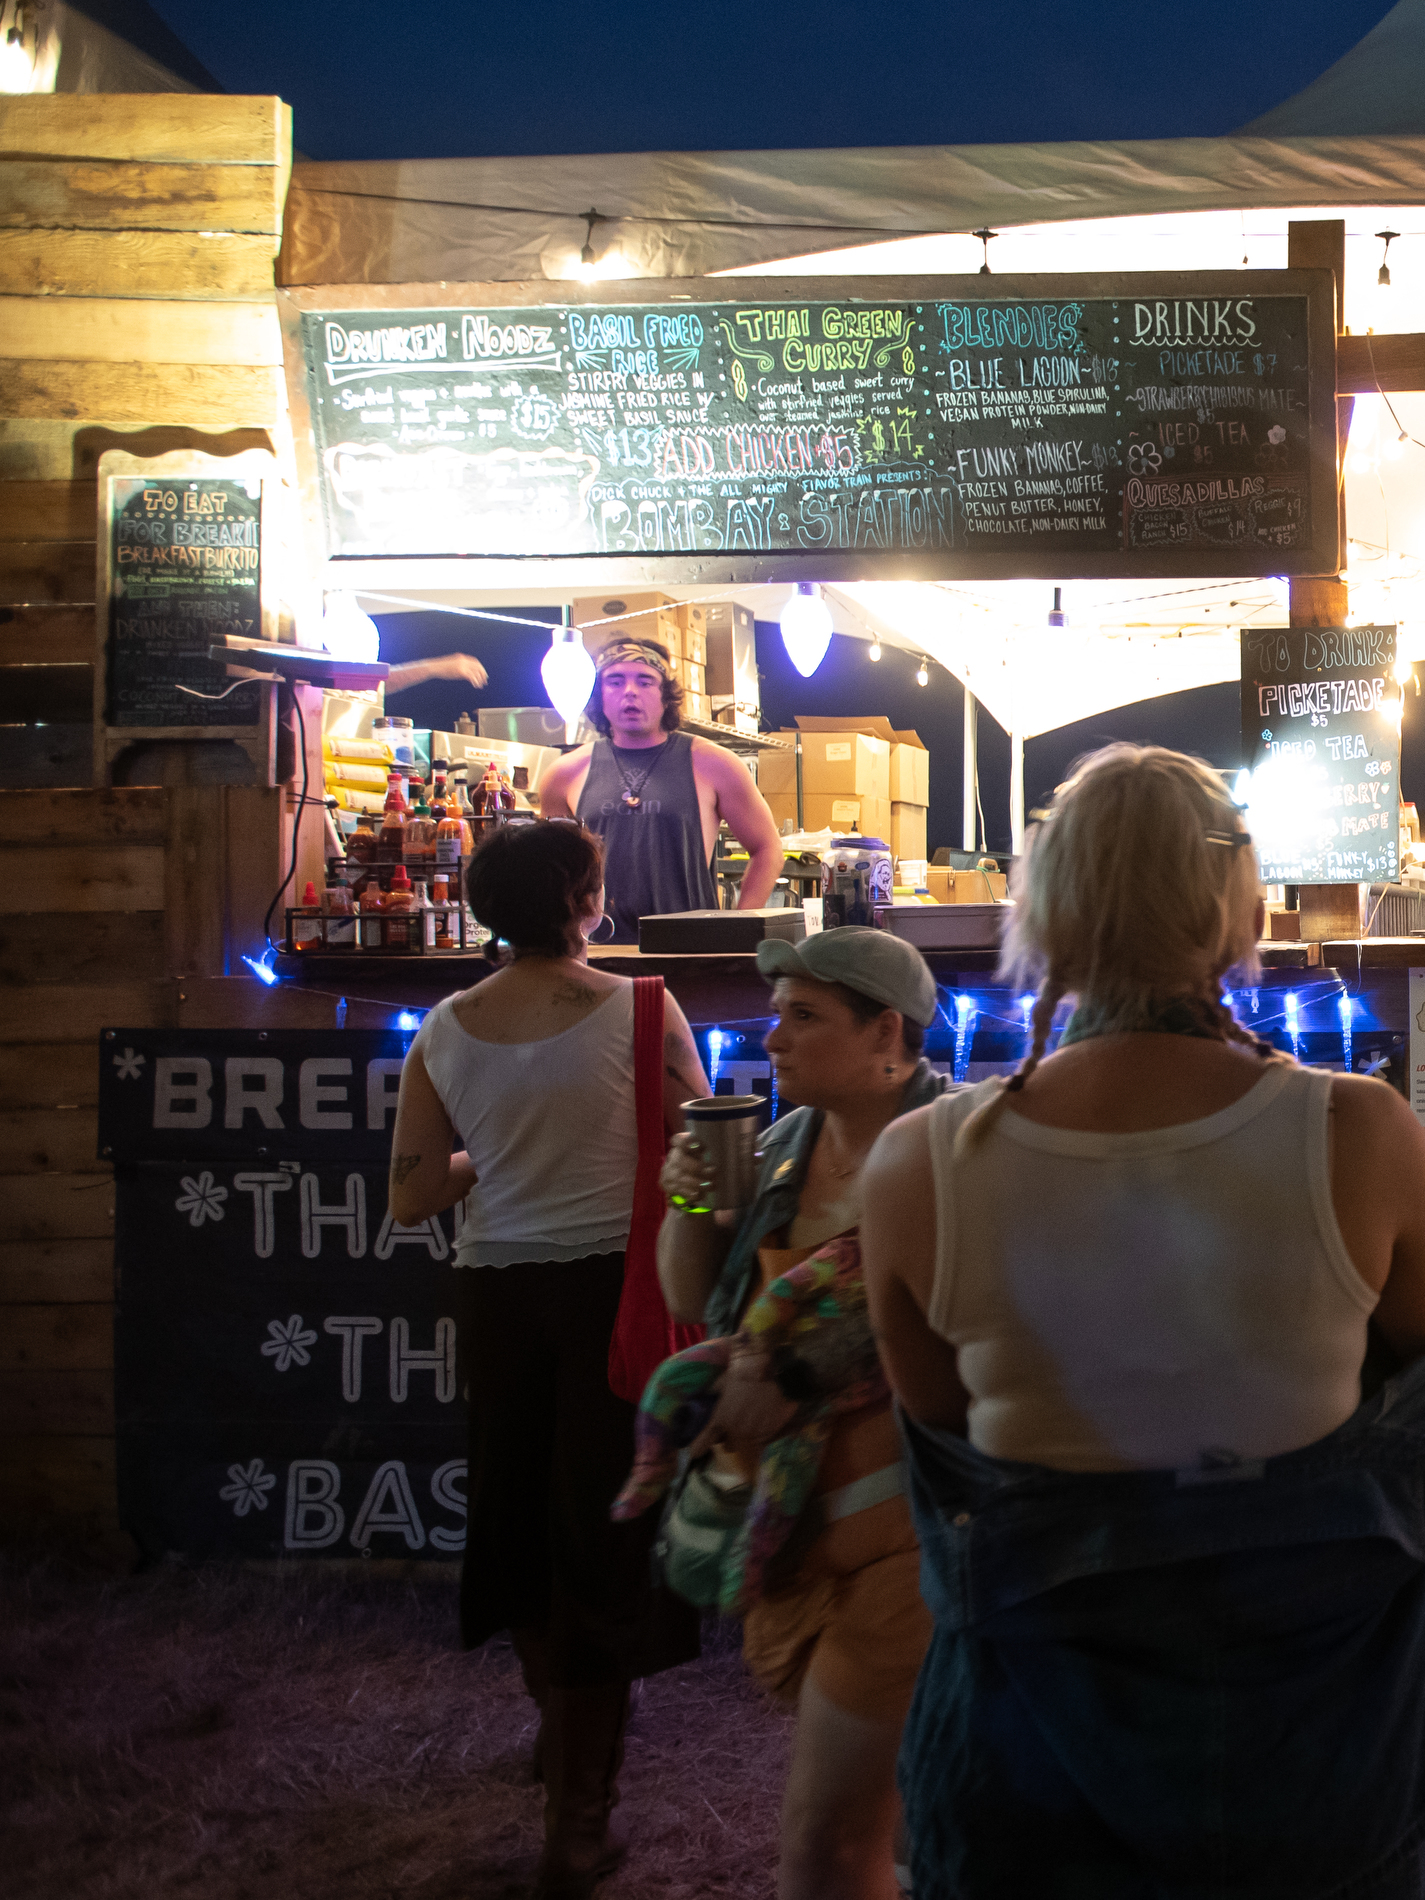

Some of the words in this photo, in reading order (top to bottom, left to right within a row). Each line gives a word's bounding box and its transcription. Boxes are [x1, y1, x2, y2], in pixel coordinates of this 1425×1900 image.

[569, 313, 640, 350] BASIL
[644, 314, 703, 348] FRIED
[736, 309, 811, 342] THAI
[822, 306, 903, 339] GREEN
[944, 305, 1078, 350] BLENDIES
[1134, 299, 1257, 338] DRINKS
[326, 322, 446, 363] DRUNKEN
[462, 315, 556, 359] NOODZ
[612, 350, 660, 376] RICE
[783, 338, 873, 373] CURRY
[1159, 349, 1246, 377] PICKETADE
[1252, 352, 1279, 376] $7
[568, 371, 629, 391] STIRFRY
[633, 372, 687, 390] VEGGIES
[693, 372, 704, 389] IN
[757, 376, 804, 397] Coconut
[812, 374, 845, 392] based
[854, 371, 884, 388] sweet
[890, 376, 915, 393] curry
[949, 357, 1006, 390] BLUE
[1019, 355, 1081, 387] LAGOON
[558, 392, 614, 410] JASMINE
[617, 392, 657, 409] FRIED
[661, 392, 691, 406] RICE
[758, 396, 777, 411] with
[828, 394, 865, 409] veggies
[872, 389, 903, 402] served
[935, 391, 978, 408] FROZEN
[1033, 390, 1056, 404] BLUE
[1057, 386, 1110, 402] SPIRULINA,
[1258, 388, 1297, 412] MATE
[521, 401, 551, 429] $15
[567, 409, 616, 427] SWEET
[624, 410, 661, 425] BASIL
[667, 408, 709, 424] SAUCE
[759, 411, 777, 422] over
[785, 409, 819, 421] steamed
[826, 408, 864, 425] jasmine
[870, 404, 891, 416] rice
[940, 408, 980, 423] VEGAN
[982, 404, 1026, 419] PROTEIN
[1011, 417, 1044, 429] MILK
[603, 427, 653, 466] $13
[872, 419, 914, 452] $14
[1159, 421, 1201, 447] ICED
[1215, 421, 1252, 446] TEA
[662, 434, 715, 474] ADD
[726, 431, 814, 472] CHICKEN
[956, 446, 1019, 481] FUNKY
[1025, 440, 1083, 475] MONKEY
[592, 486, 624, 503] DICK
[630, 485, 671, 500] CHUCK
[691, 484, 713, 498] THE
[720, 484, 742, 497] ALL
[752, 481, 788, 496] MIGHTY
[842, 473, 873, 489] TRAIN
[958, 481, 1008, 499] FROZEN
[1066, 474, 1109, 494] COFFEE,
[1127, 476, 1265, 509] QUESADILLAS
[143, 489, 179, 512] TO
[182, 491, 228, 515] EAT
[965, 502, 1007, 517] PENUT
[1011, 498, 1061, 515] BUTTER,
[1063, 497, 1104, 513] HONEY,
[1197, 505, 1233, 518] BUFFALO
[601, 496, 776, 553] BOMBAY
[797, 486, 955, 549] STATION
[968, 518, 1032, 535] CHOCOLATE,
[1032, 517, 1080, 531] NON-DAIRY
[1083, 516, 1107, 530] MILK
[1138, 511, 1177, 522] CHICKEN
[1144, 521, 1169, 531] BACON
[1169, 521, 1188, 538] $15
[1228, 520, 1246, 538] $14
[118, 519, 168, 545] FOR
[117, 545, 205, 569] BREAKFAST
[203, 546, 259, 571] BURRITO
[1247, 633, 1291, 673] TO
[1258, 677, 1385, 718] PICKETADE
[1310, 713, 1329, 728] $5
[1324, 733, 1370, 761] TEA
[1340, 811, 1390, 837] MATE
[1326, 850, 1369, 868] FUNKY
[1366, 855, 1388, 874] $13
[233, 1171, 451, 1261] THA
[284, 1458, 468, 1551] BAS
